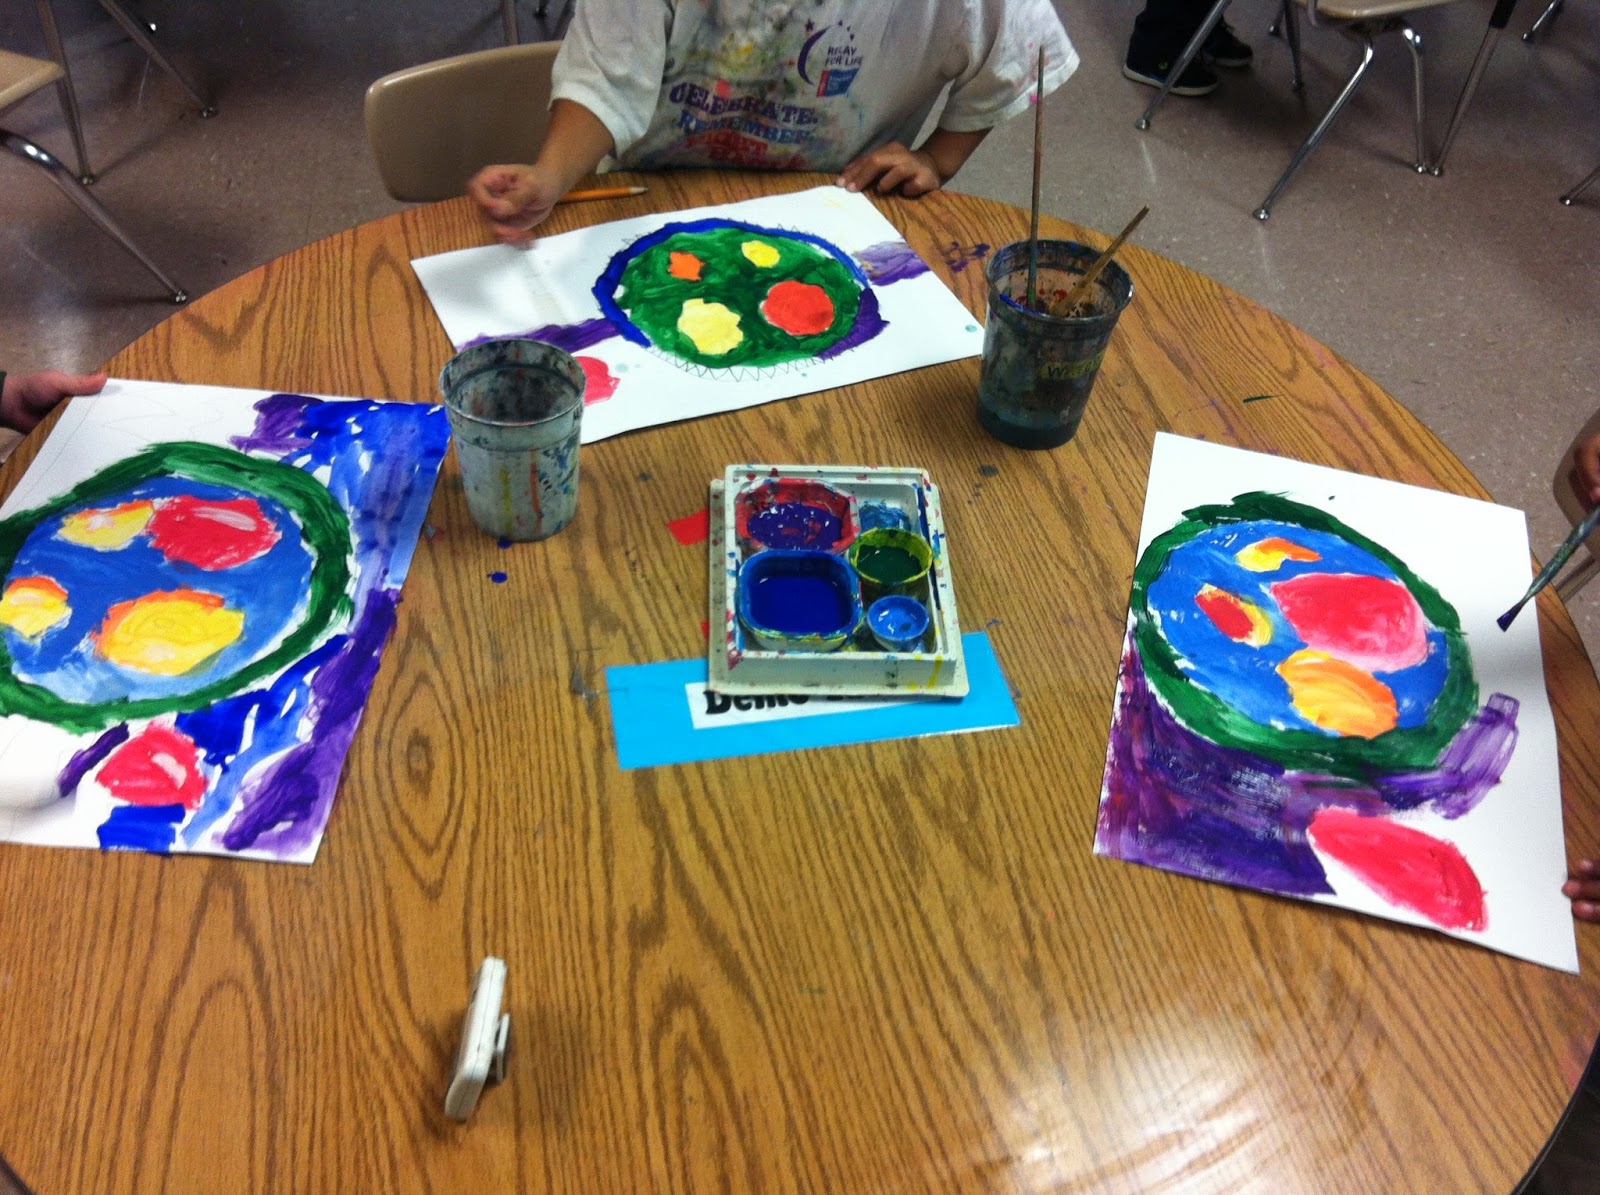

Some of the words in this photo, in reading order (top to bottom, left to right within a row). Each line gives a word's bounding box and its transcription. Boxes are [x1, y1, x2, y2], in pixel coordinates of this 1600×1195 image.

[828, 46, 857, 56] RELAY
[825, 56, 842, 66] FOR
[845, 55, 863, 66] LIFE
